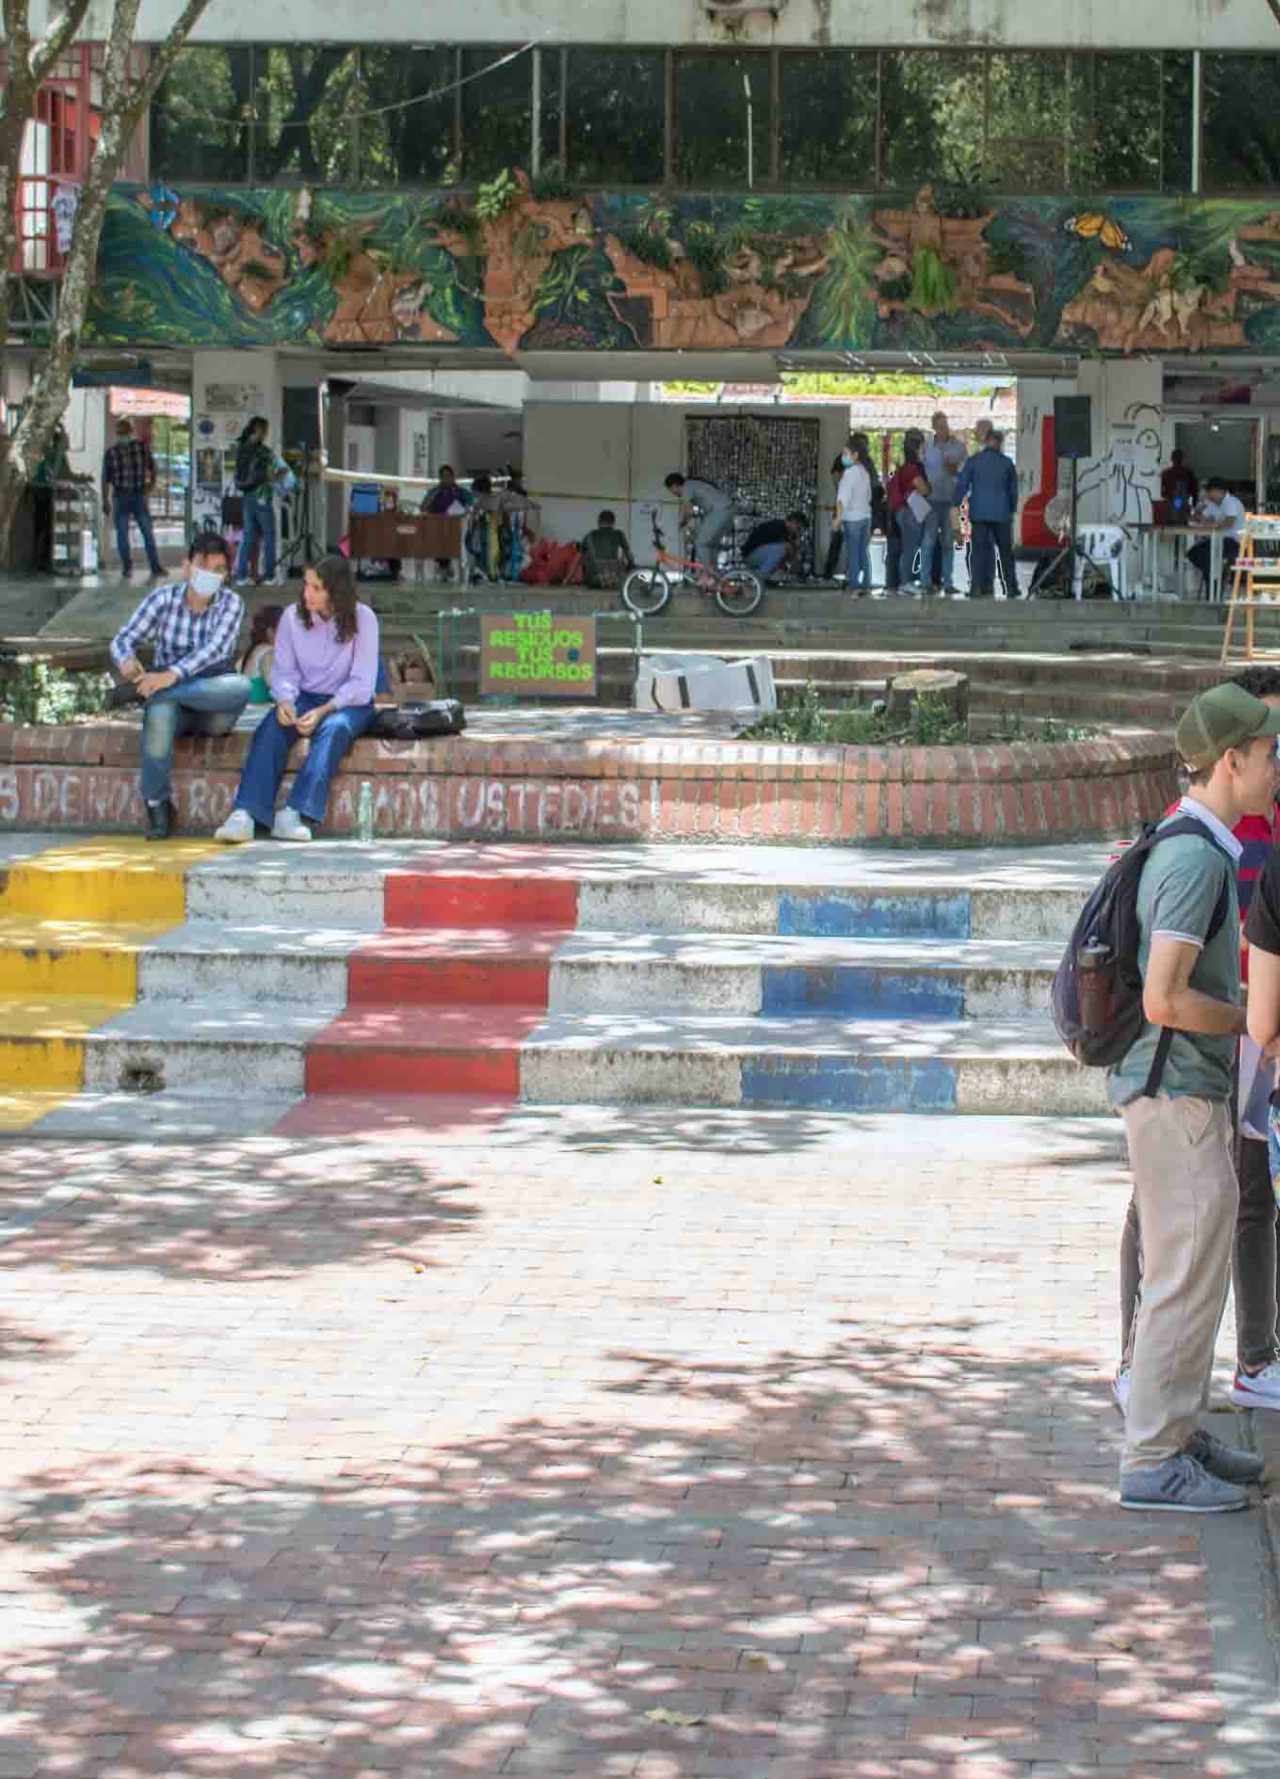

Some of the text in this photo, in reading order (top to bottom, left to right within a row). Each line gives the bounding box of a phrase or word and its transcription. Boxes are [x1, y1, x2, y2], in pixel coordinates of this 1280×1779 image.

[512, 611, 553, 629] TUS
[488, 630, 585, 649] RESIDUOS
[515, 645, 554, 664] TUS
[488, 661, 594, 681] RECURSOS
